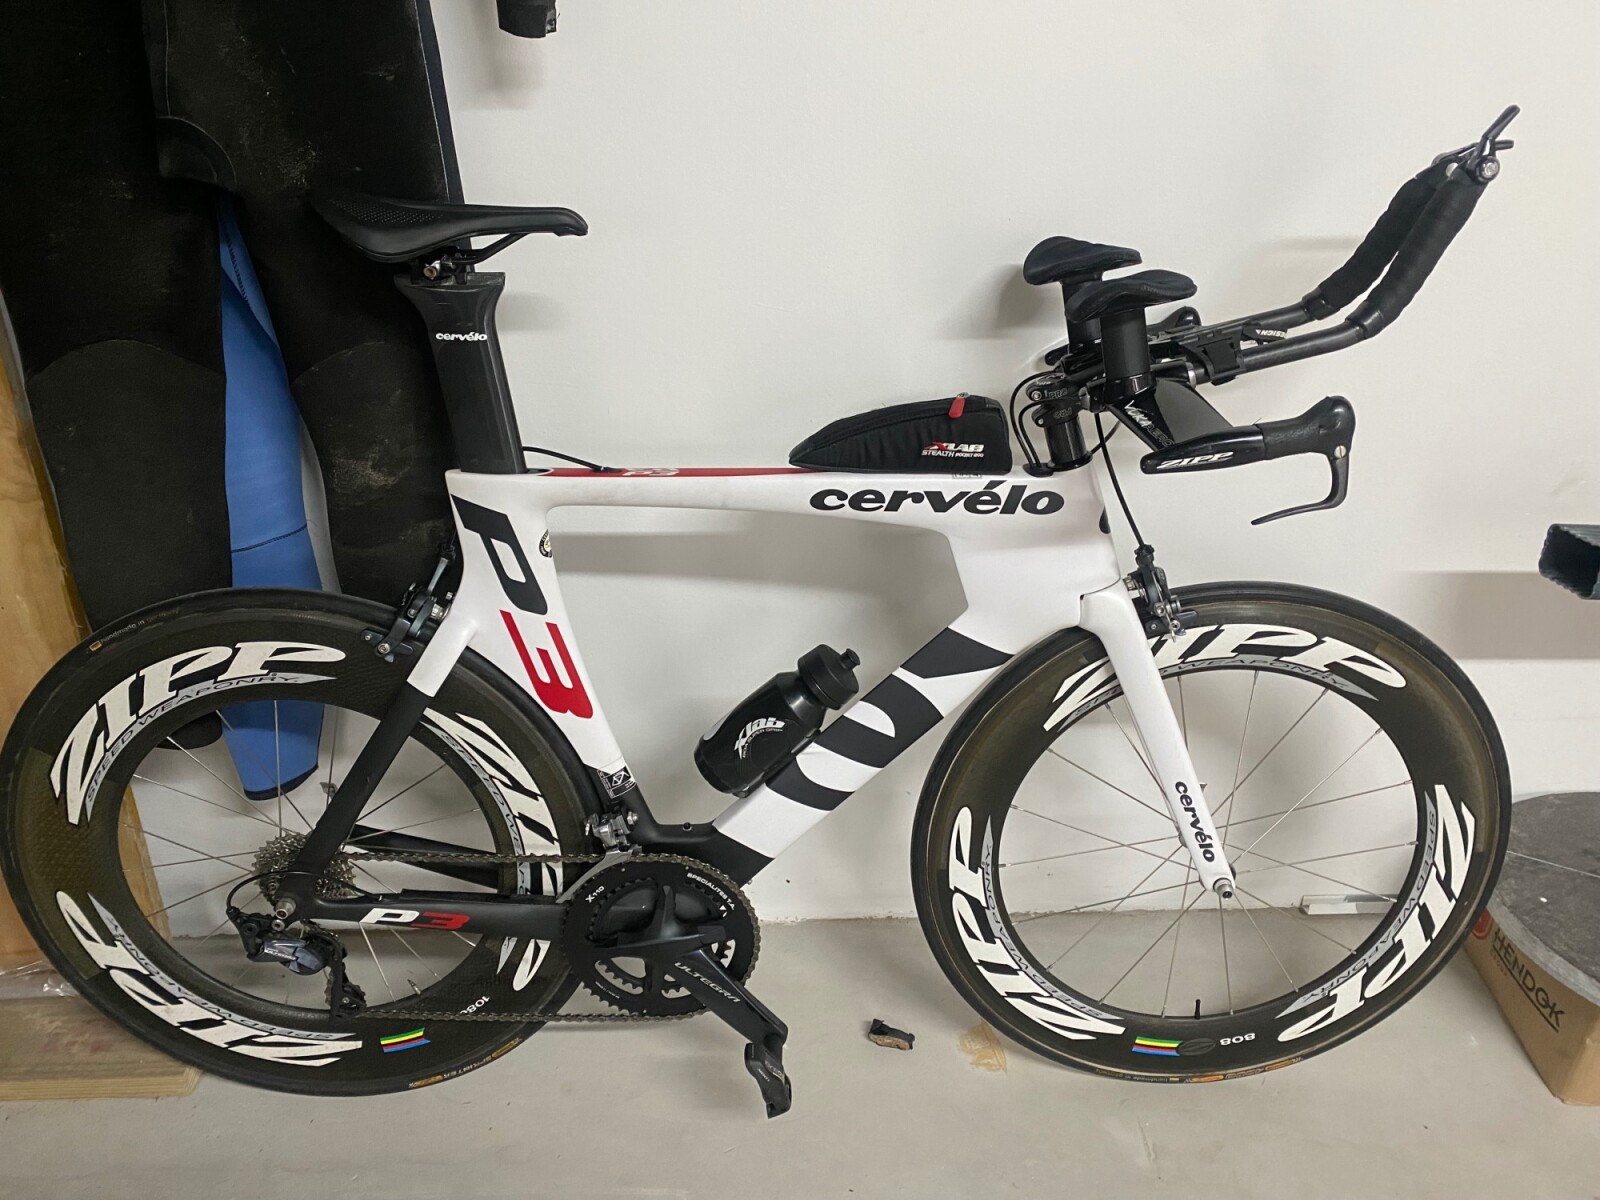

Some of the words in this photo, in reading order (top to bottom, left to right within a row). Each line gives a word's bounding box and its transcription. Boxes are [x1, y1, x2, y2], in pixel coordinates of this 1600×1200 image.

[435, 331, 488, 342] cervélo
[809, 479, 1065, 515] cervélo
[1156, 451, 1234, 470] ZIPP
[1177, 657, 1344, 689] WEAPONRY
[50, 641, 346, 826] ZIPP
[87, 730, 135, 802] SPEED
[137, 674, 299, 727] WEAPONRY
[1174, 781, 1217, 864] cervélo
[1413, 812, 1437, 892] SPEED
[359, 907, 471, 931] P3
[948, 806, 1126, 1041] ZIPP
[982, 845, 1030, 973] WEAPONRY
[1278, 784, 1475, 1042] ZIPP
[1303, 895, 1419, 1004] WEAPONRY
[56, 890, 363, 1066] ZIPP
[106, 915, 236, 1021] WEAPONRY
[674, 962, 741, 1003] ULTEGRA
[1032, 973, 1104, 1019] SPEED
[1493, 926, 1565, 1029] HENDOK
[237, 1017, 335, 1041] SPEED
[1219, 1032, 1256, 1046] 808
